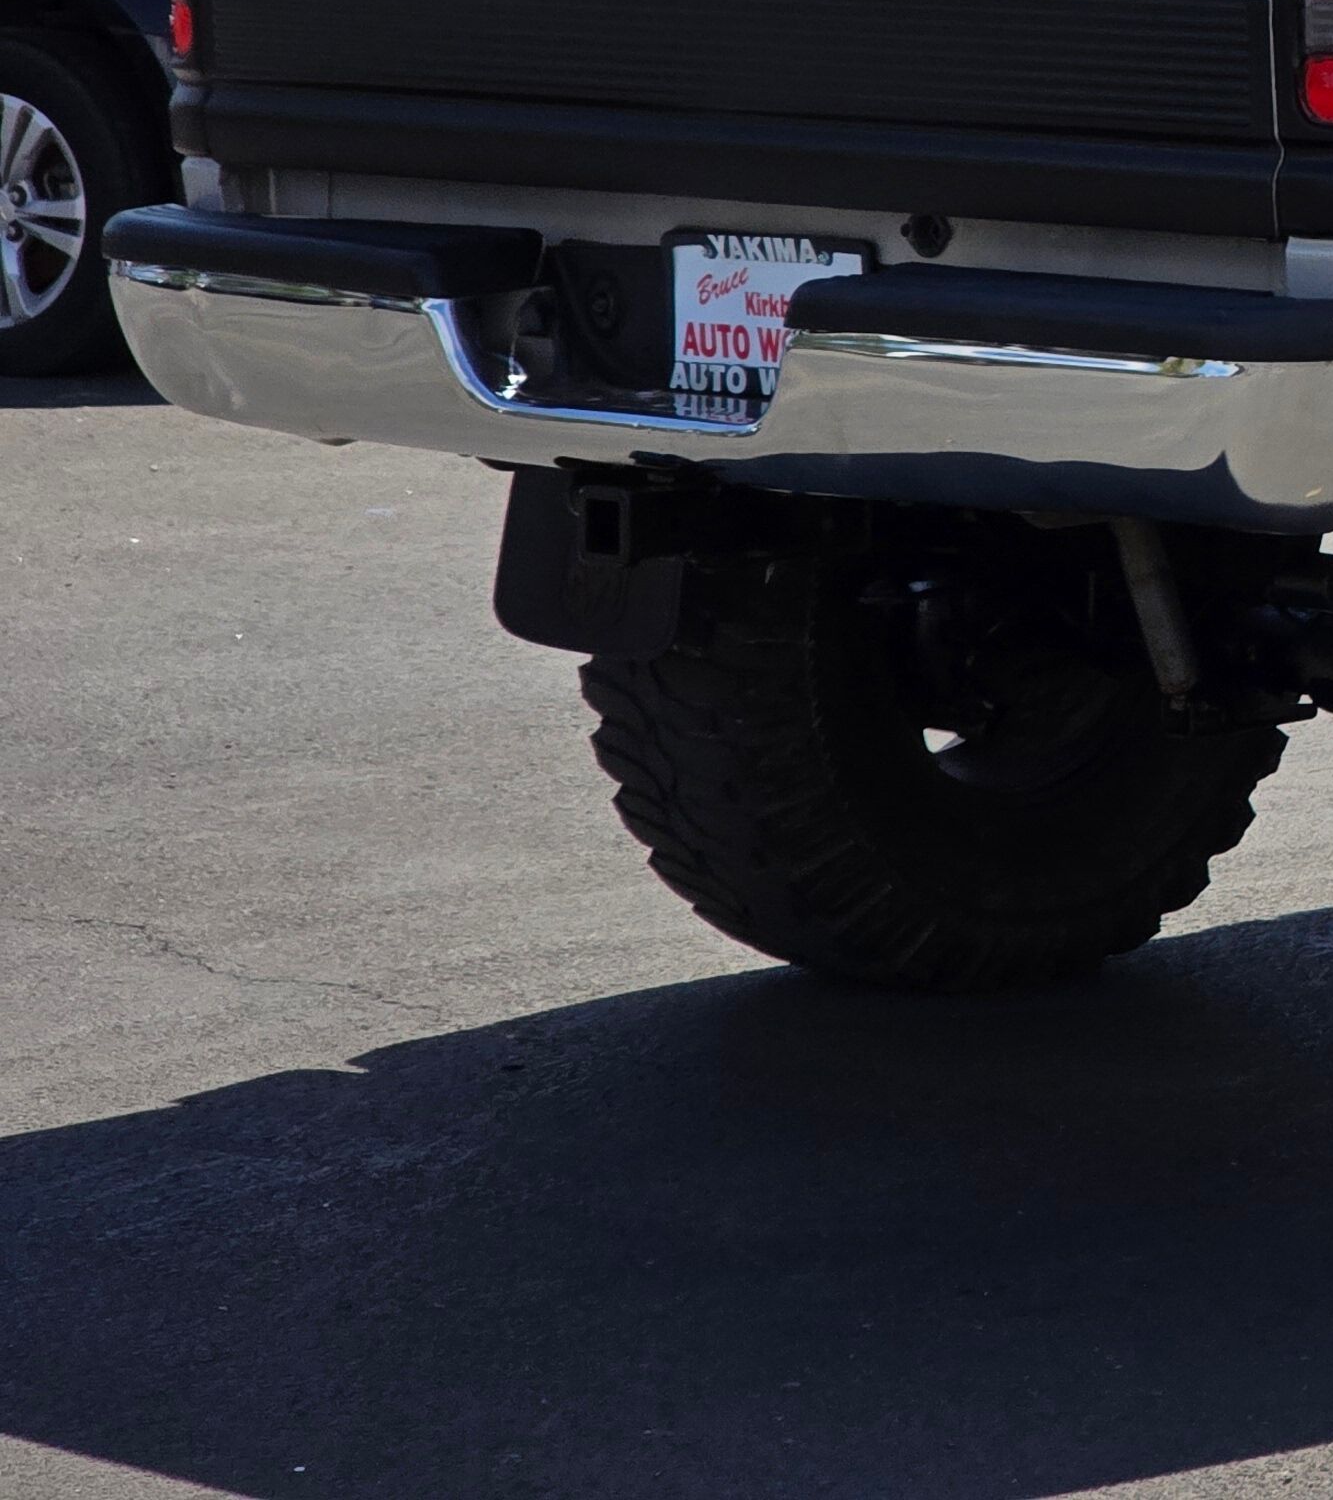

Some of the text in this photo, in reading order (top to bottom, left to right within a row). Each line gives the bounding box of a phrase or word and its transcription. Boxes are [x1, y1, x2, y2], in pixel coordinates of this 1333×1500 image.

[706, 234, 819, 264] YAKIMA
[697, 266, 749, 306] Bruce
[682, 321, 751, 360] AUTO
[669, 361, 748, 395] AUTO
